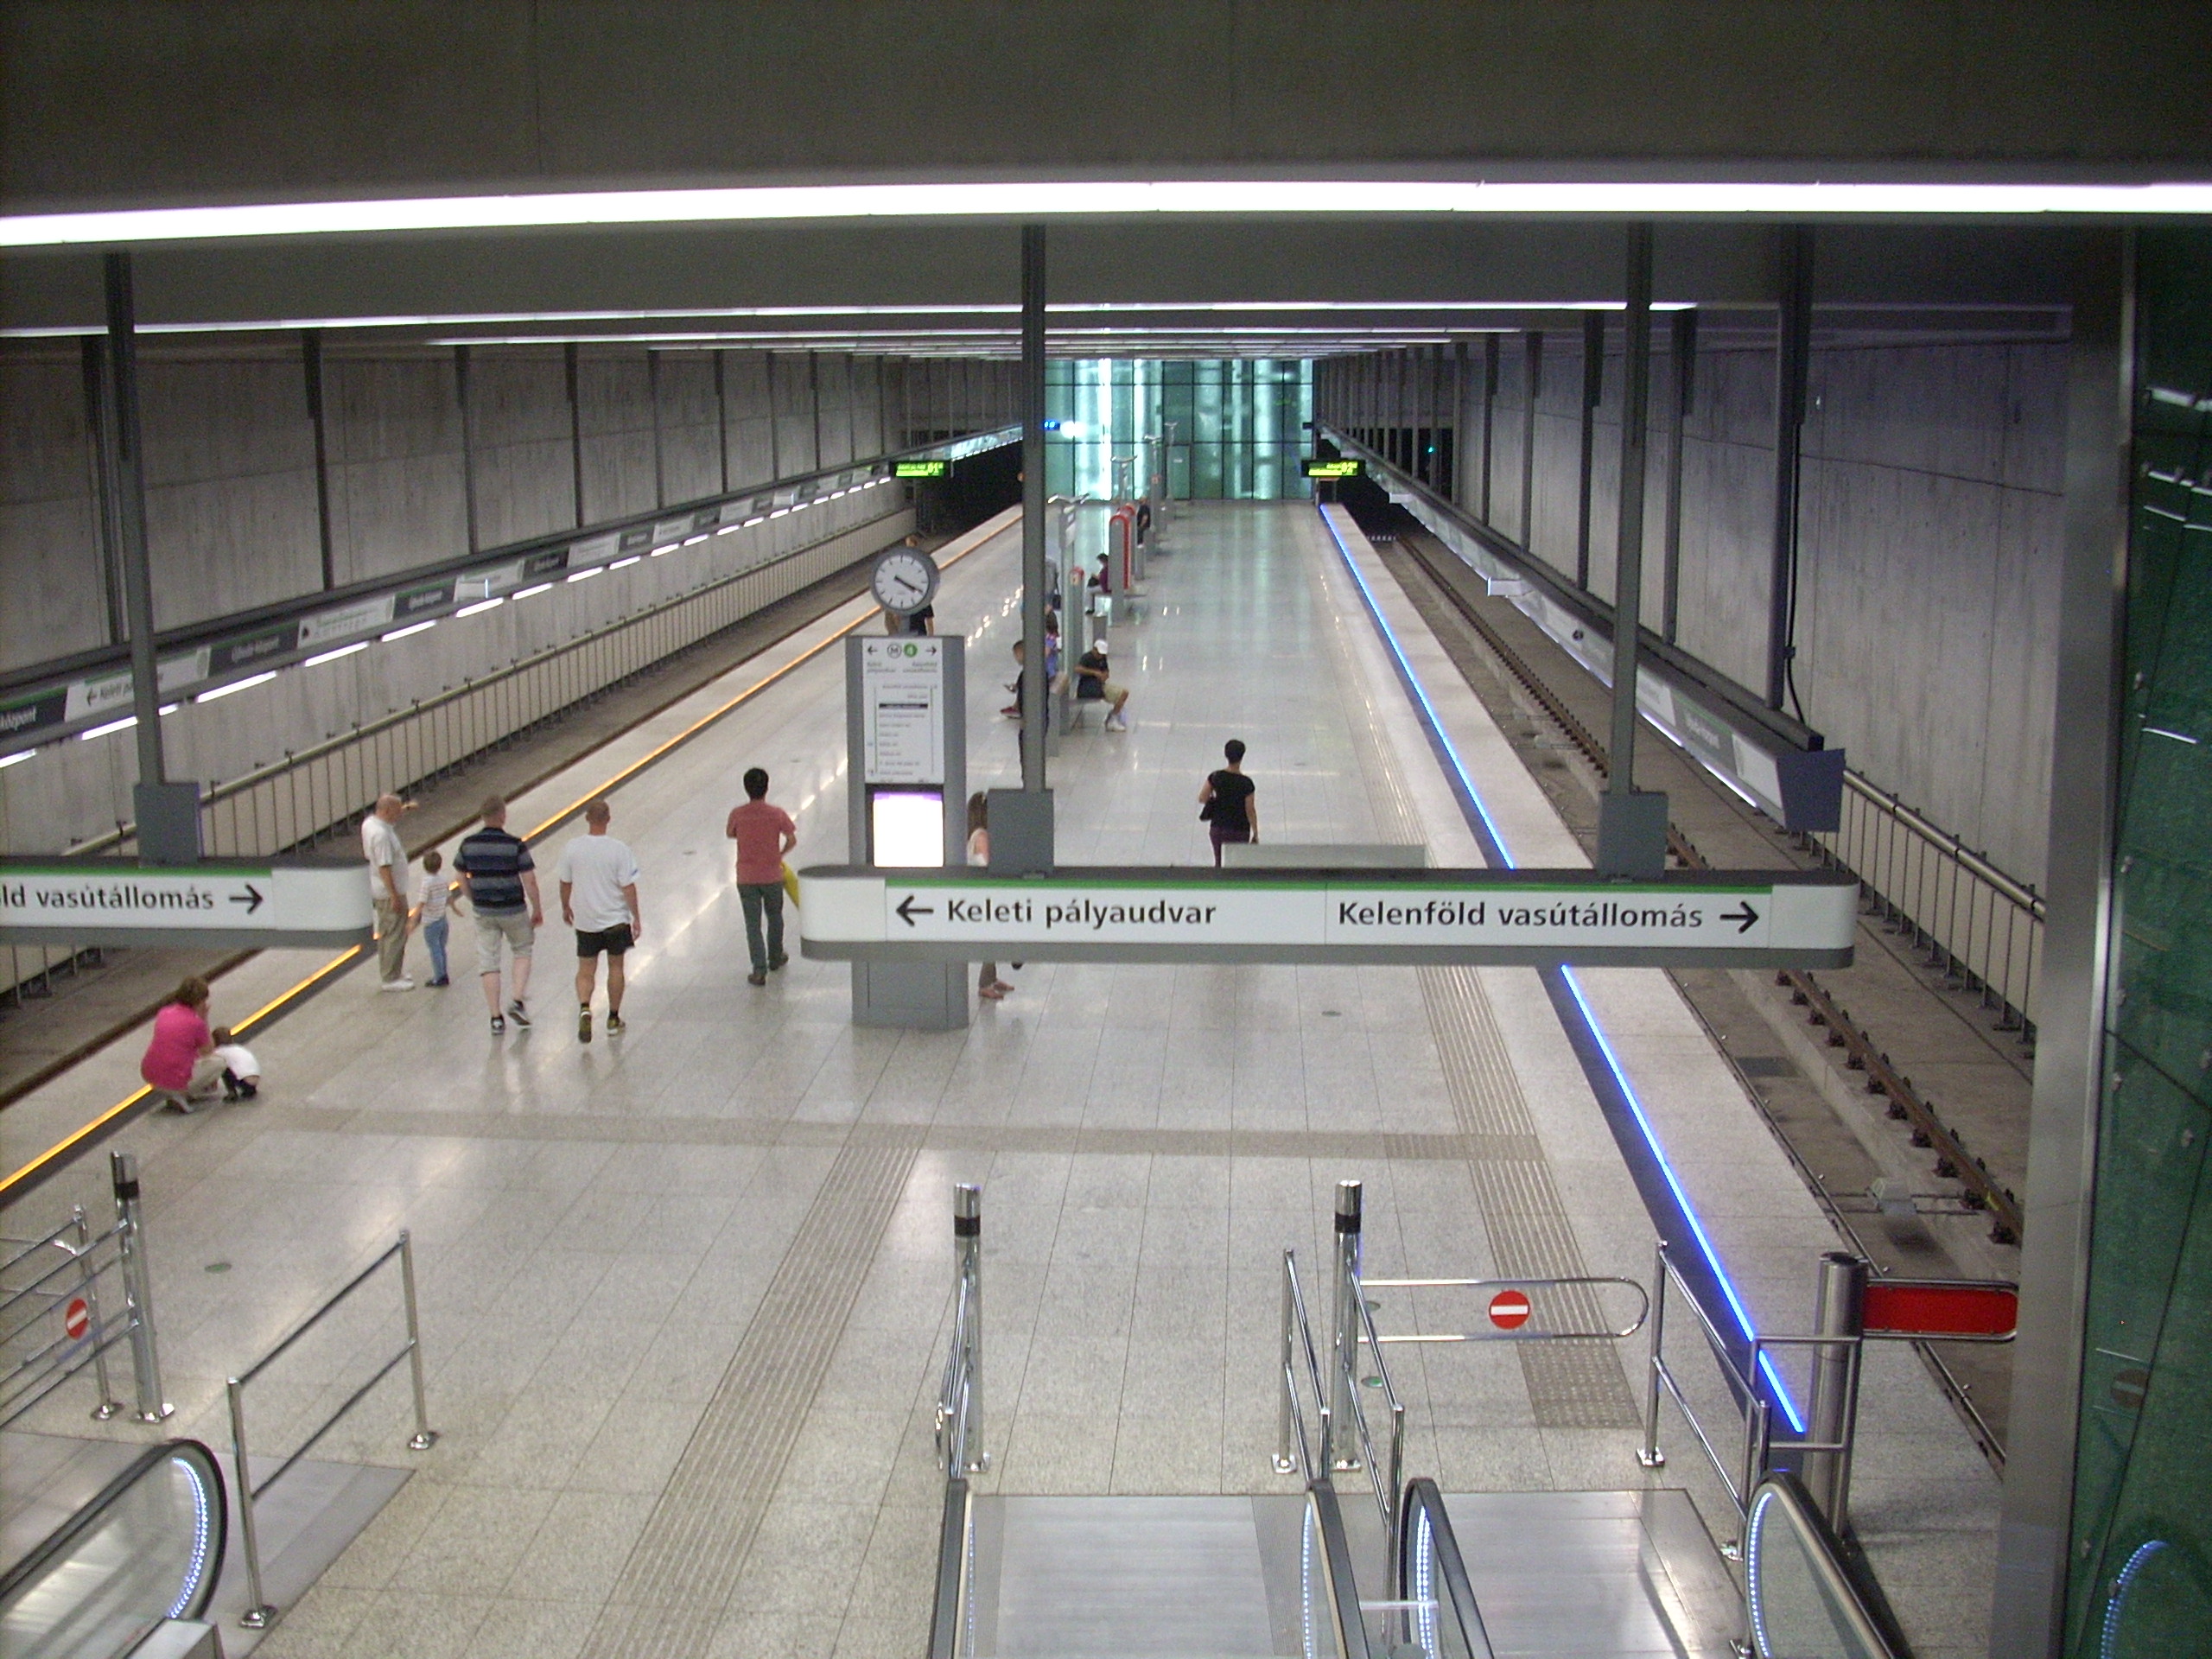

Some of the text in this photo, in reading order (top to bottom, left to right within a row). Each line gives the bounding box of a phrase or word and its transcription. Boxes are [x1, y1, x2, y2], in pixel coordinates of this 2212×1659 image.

[0, 882, 214, 910] ld vasútállomás
[948, 898, 1217, 930] Keleti pályaudvar
[1338, 900, 1704, 928] Kelenföld vasútállomás
